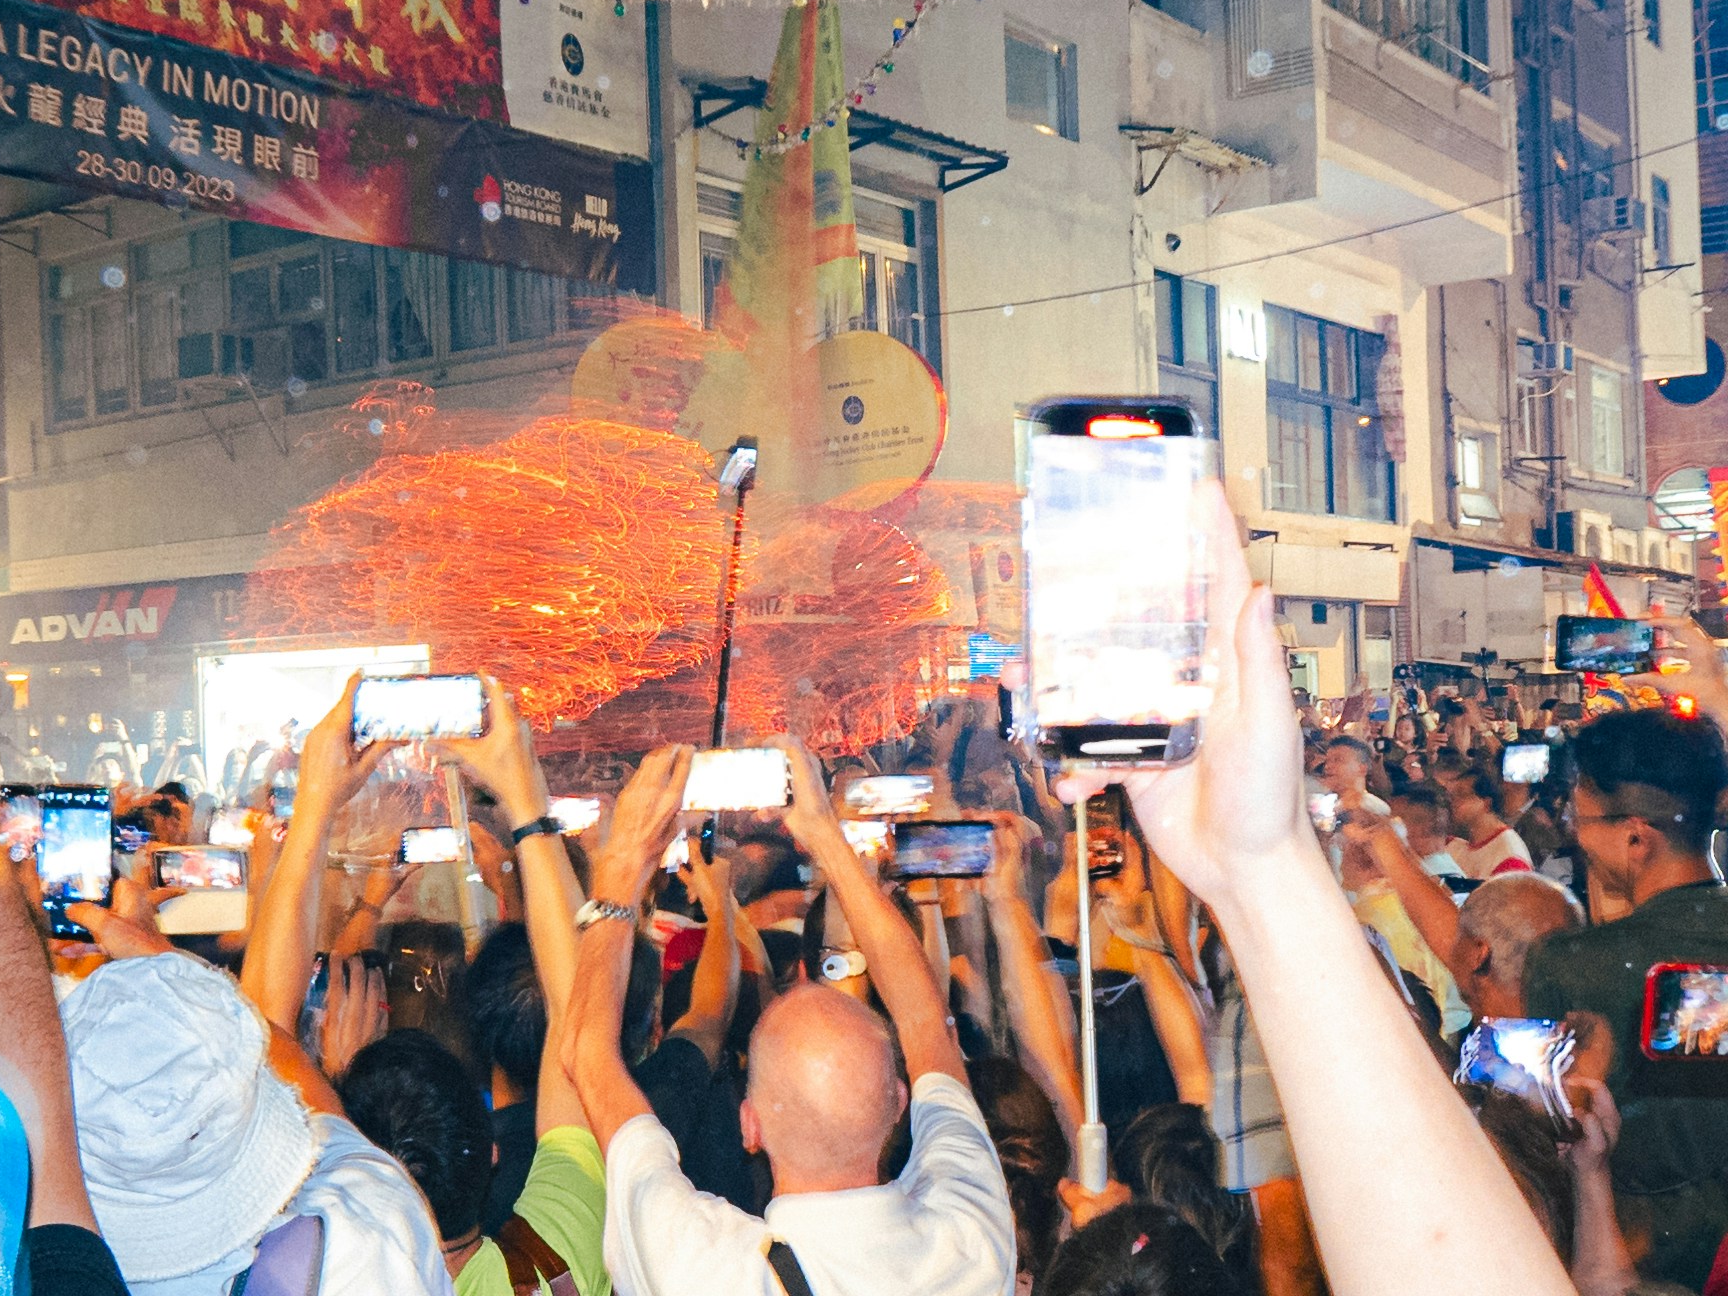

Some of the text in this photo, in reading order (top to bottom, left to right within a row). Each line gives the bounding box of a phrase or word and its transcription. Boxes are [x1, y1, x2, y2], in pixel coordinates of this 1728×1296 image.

[17, 24, 153, 88] LEGACY
[162, 60, 194, 100] IN
[203, 71, 320, 129] MOTION
[169, 115, 320, 181] 活現眼前
[76, 150, 235, 202] 28-30.09.2023
[503, 179, 562, 203] HONG KONG
[10, 607, 159, 646] ADVAN
